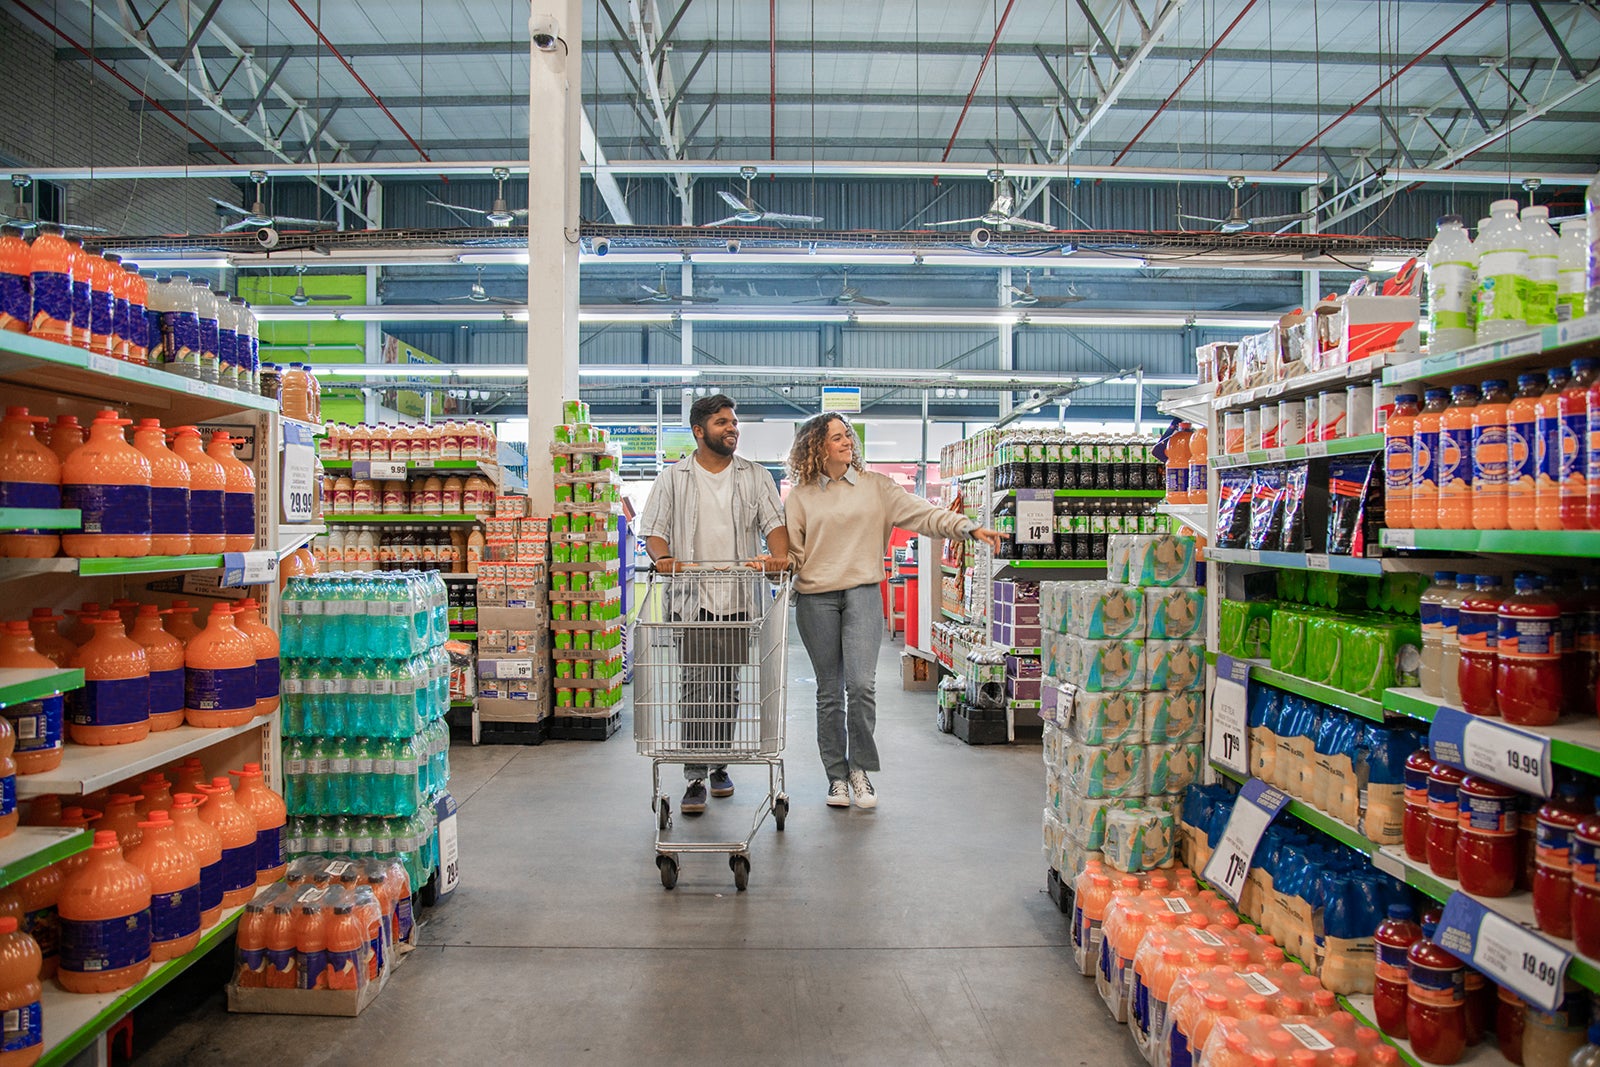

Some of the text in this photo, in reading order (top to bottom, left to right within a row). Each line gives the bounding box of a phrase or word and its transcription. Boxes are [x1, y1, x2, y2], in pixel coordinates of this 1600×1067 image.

[391, 466, 406, 474] 9.99
[290, 492, 312, 513] 29.99
[1507, 750, 1539, 776] 19.99
[1522, 952, 1556, 987] 19.99
